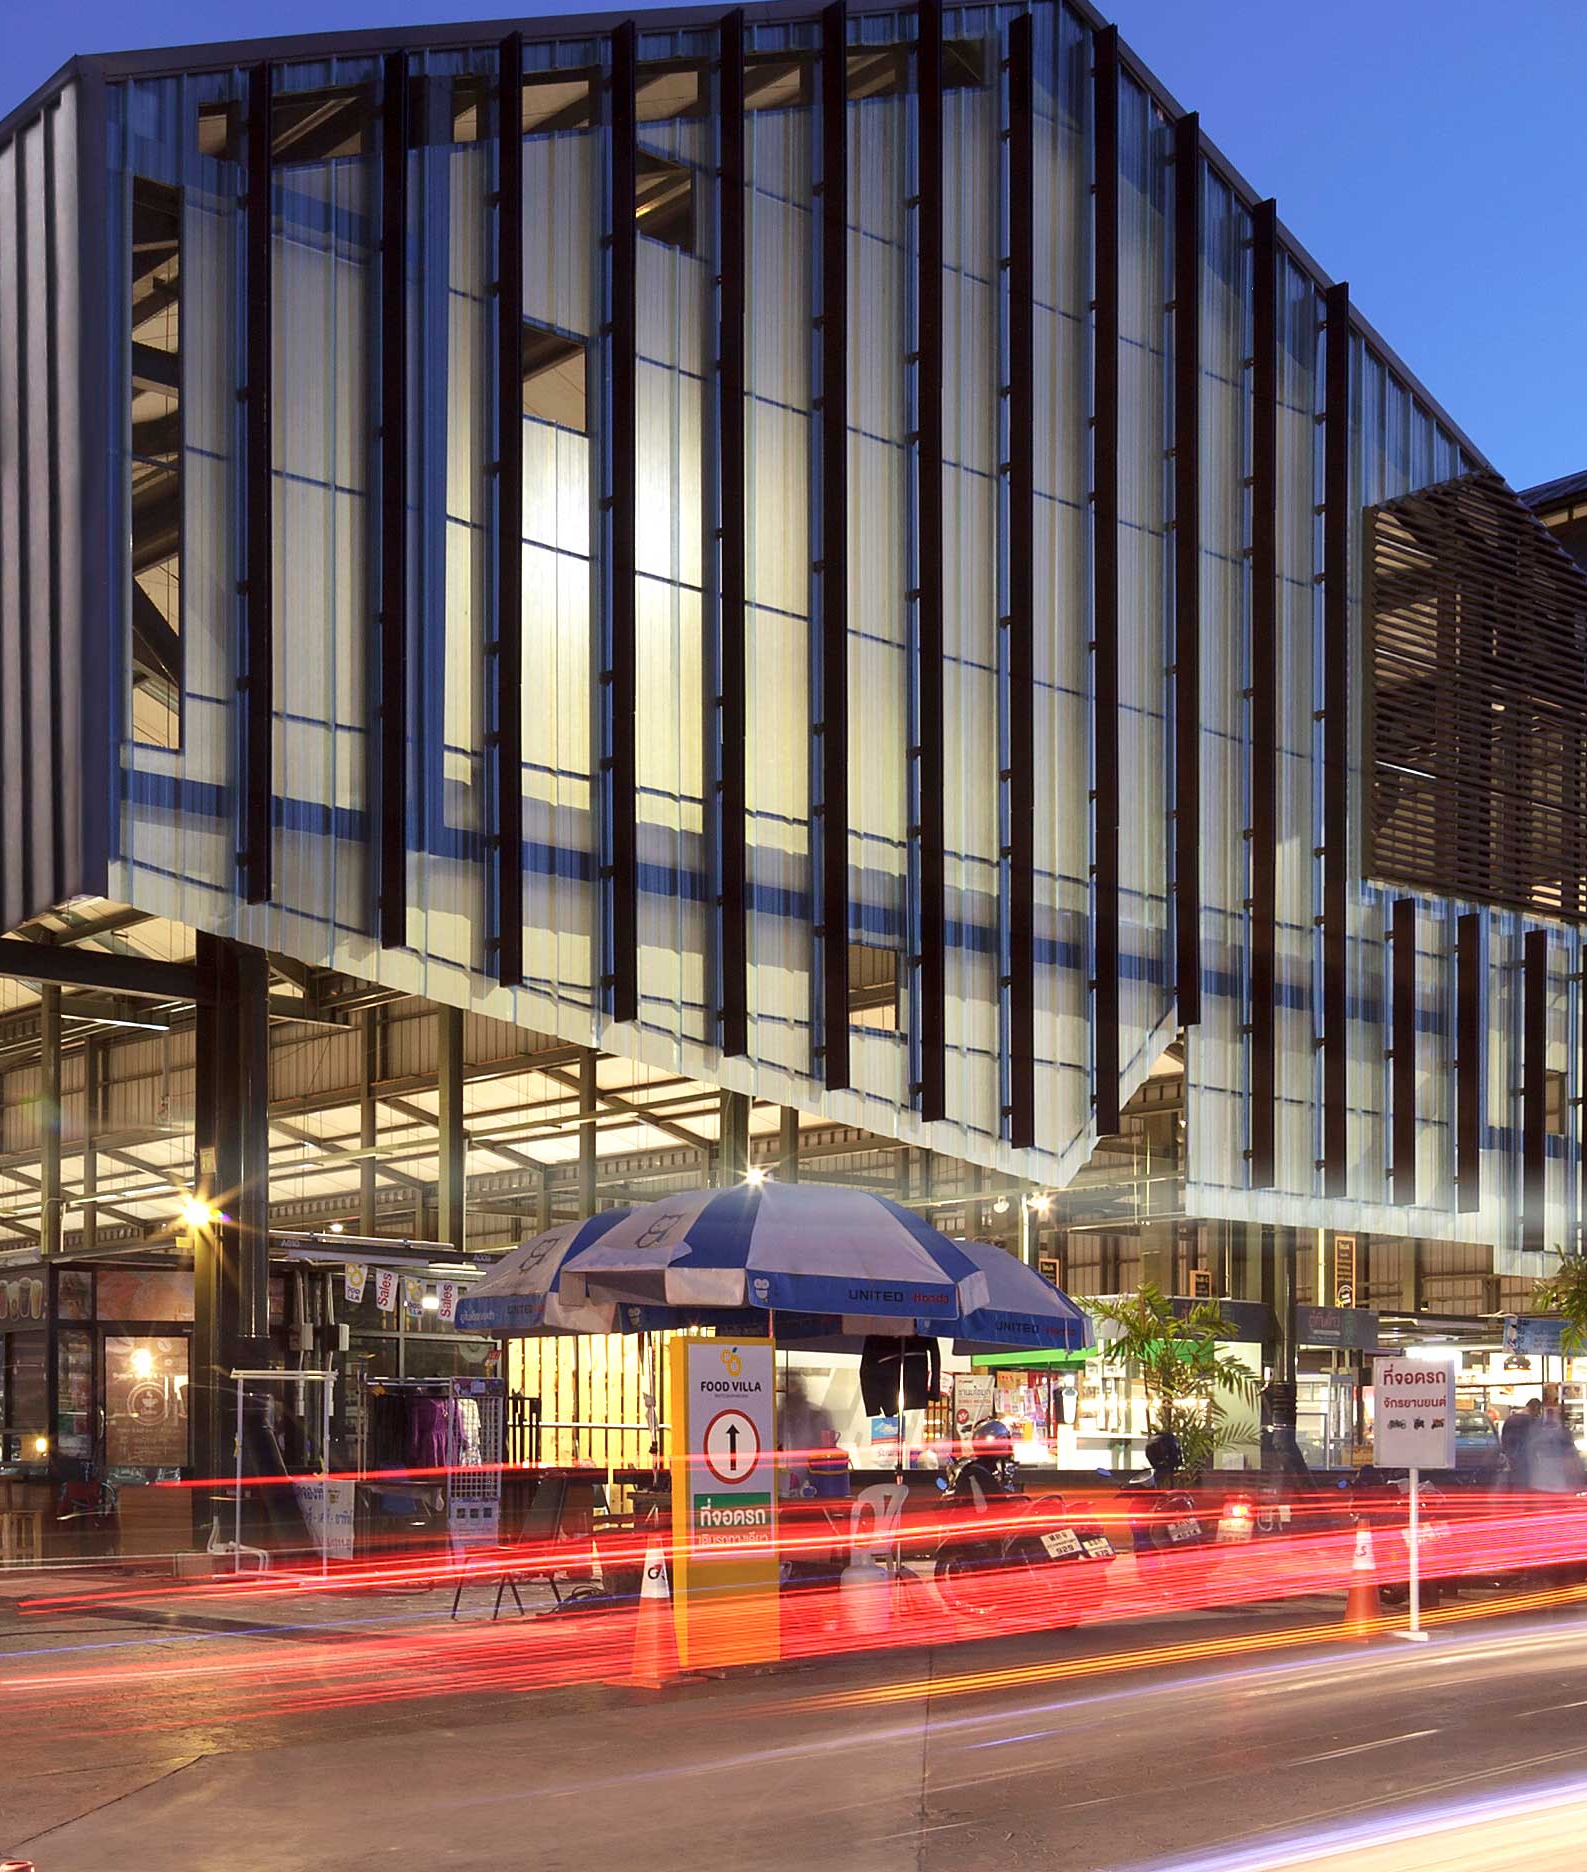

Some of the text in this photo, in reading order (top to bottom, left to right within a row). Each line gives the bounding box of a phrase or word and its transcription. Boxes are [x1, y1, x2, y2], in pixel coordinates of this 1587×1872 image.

[377, 1272, 393, 1307] Sales
[440, 1283, 453, 1319] Sales
[847, 1289, 904, 1303] UNITED
[1384, 1363, 1446, 1386] ที่จอดรถ
[700, 1381, 762, 1393] FOOD VILLA
[1383, 1395, 1447, 1408] จักรยานยนต์
[700, 1498, 766, 1527] ที่จอดรถ
